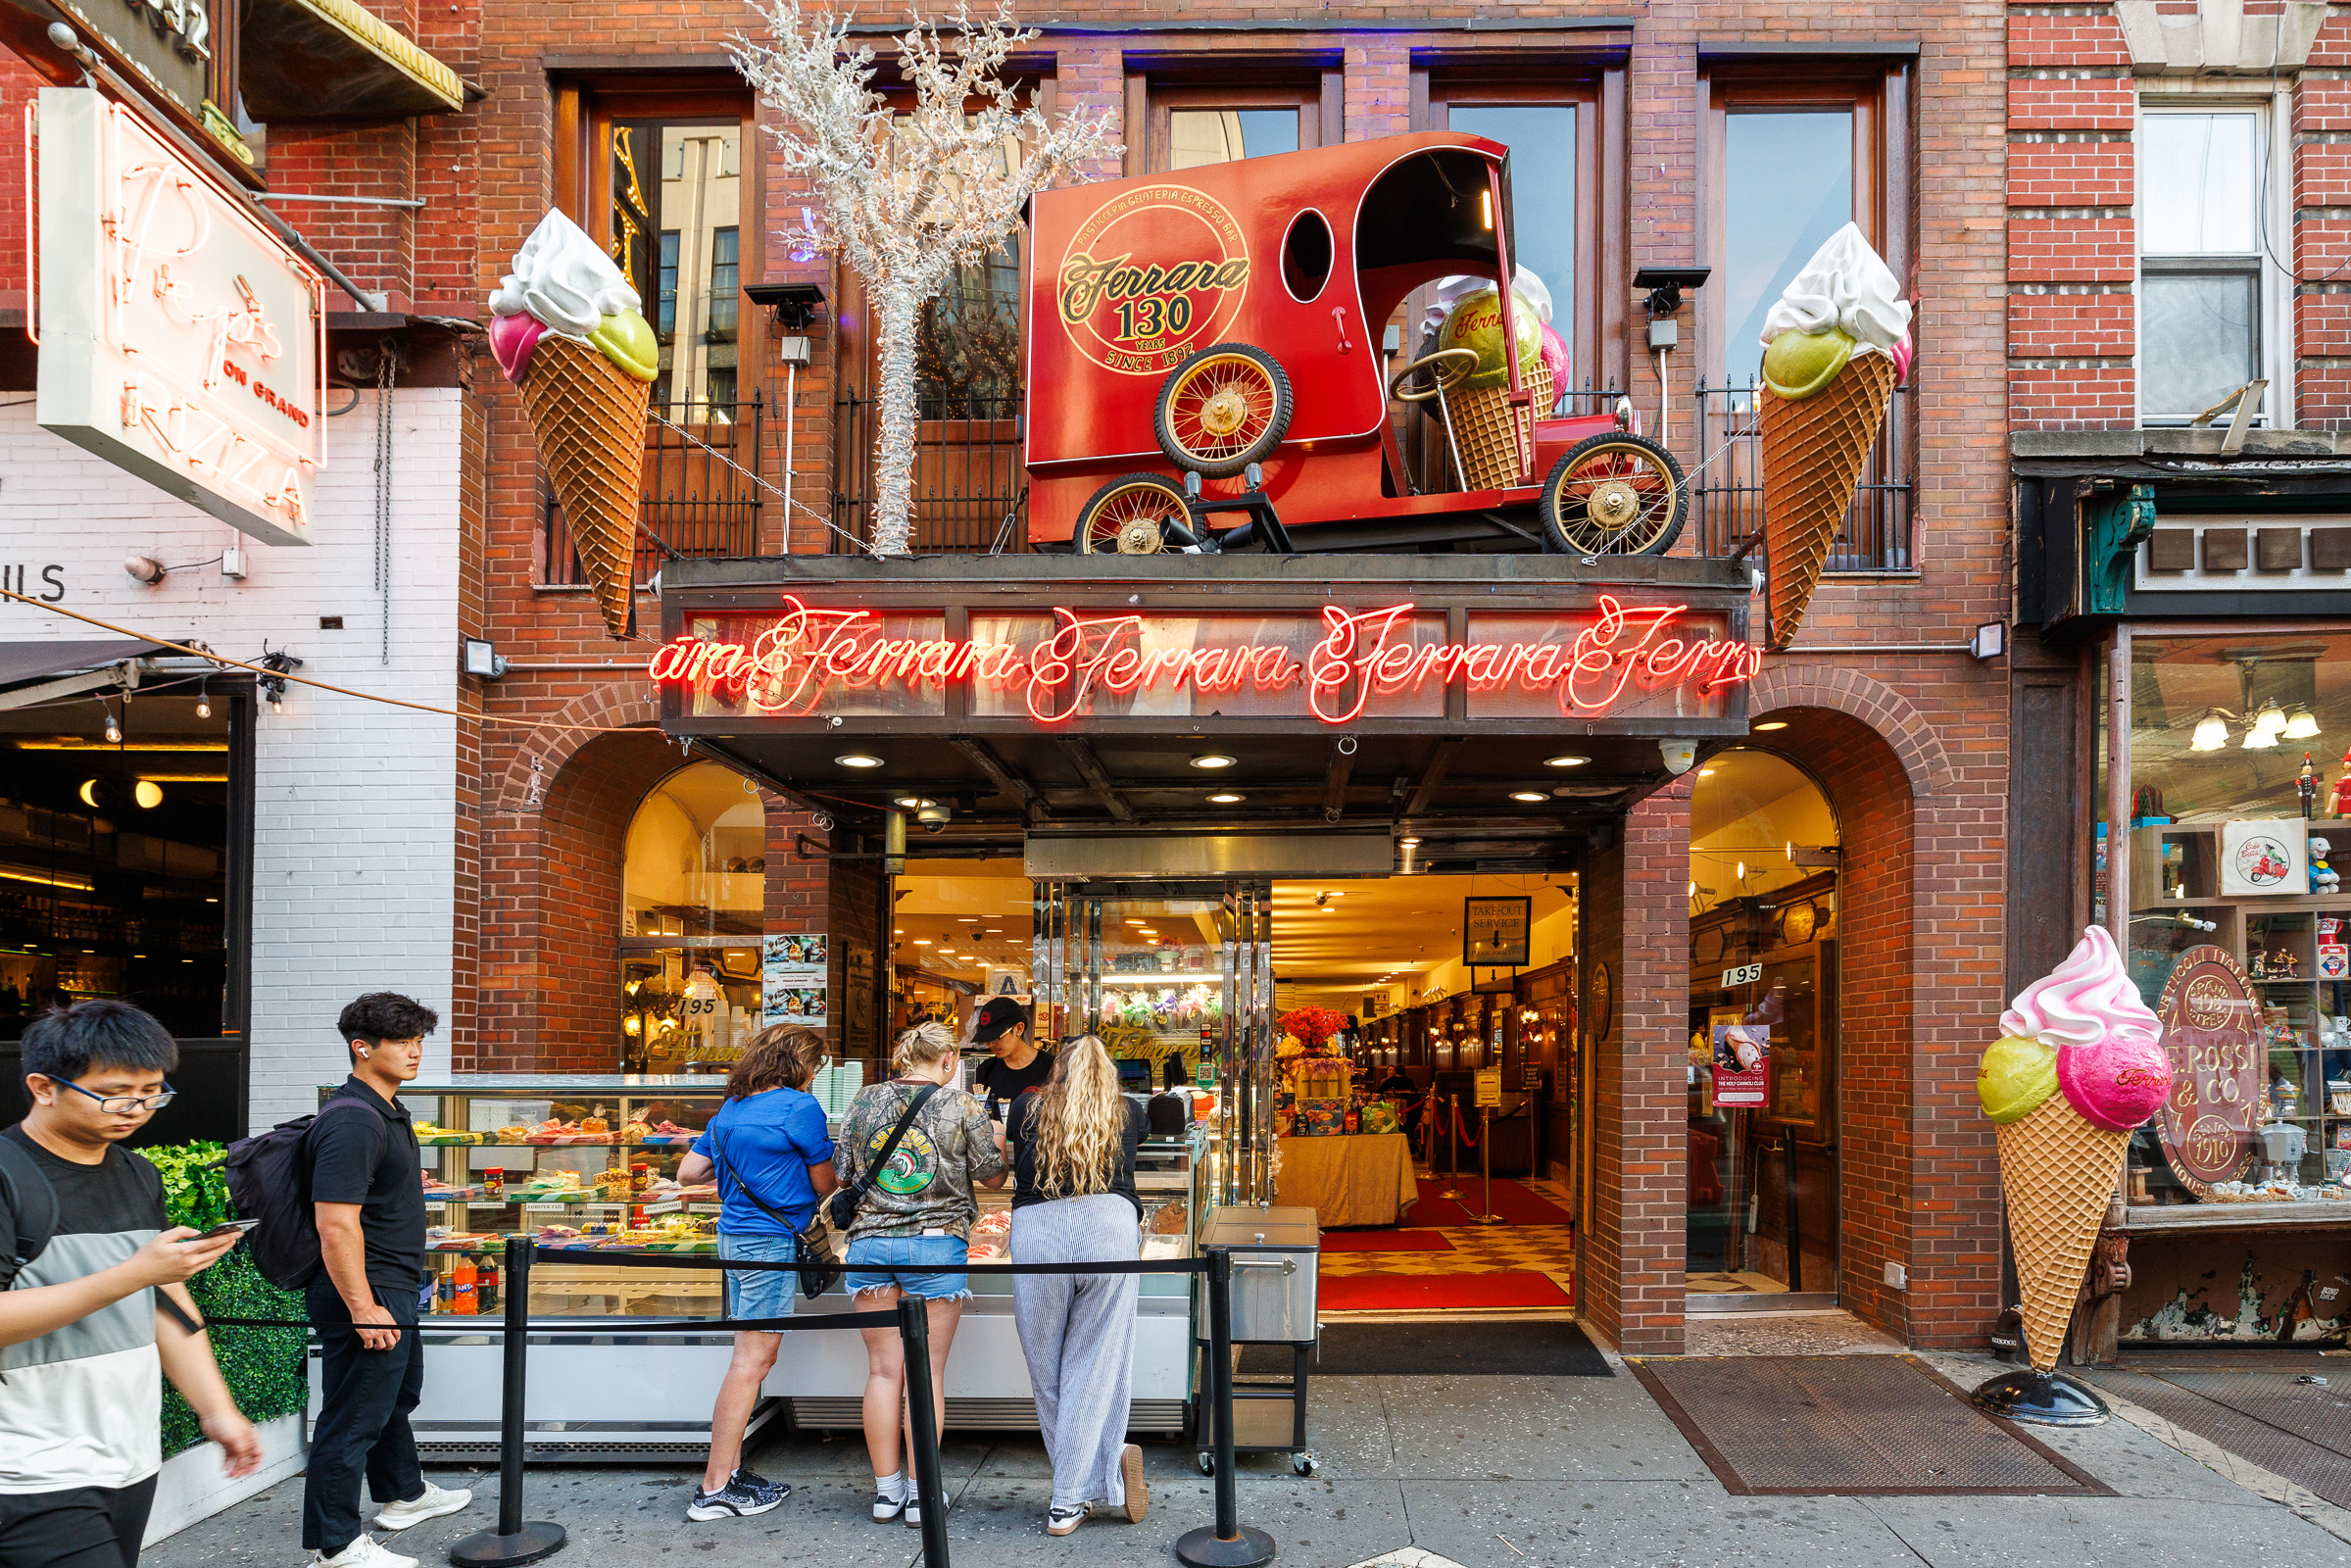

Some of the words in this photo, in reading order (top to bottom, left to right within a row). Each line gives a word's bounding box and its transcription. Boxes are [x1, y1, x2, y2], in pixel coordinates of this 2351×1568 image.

[1077, 201, 1128, 246] PASTICCERIA
[1222, 221, 1239, 243] BAR
[1061, 252, 1250, 324] Ferrara
[1113, 294, 1193, 341] 130
[1135, 338, 1165, 351] YEARS
[1105, 351, 1152, 370] SINCE
[1161, 342, 1196, 368] 1892
[223, 359, 247, 387] ON
[253, 379, 311, 429] GRAND
[747, 594, 1015, 711] Ferrara
[1026, 607, 1298, 723] Ferrara
[1309, 603, 1569, 722] Ferrara
[1472, 906, 1523, 916] TAKE-OUT
[1473, 918, 1520, 928] SERVICE
[1726, 964, 1760, 986] 195
[2156, 948, 2207, 1022] ARTICOLI
[2213, 948, 2263, 1019] ITALIANI
[2190, 979, 2229, 998] GRAND
[679, 999, 716, 1015] 195
[2188, 1007, 2229, 1026] STREET
[2178, 1079, 2199, 1107] &
[2206, 1077, 2246, 1103] CO.
[2192, 1121, 2233, 1142] SINCE
[2195, 1138, 2229, 1164] 1910
[659, 1201, 681, 1210] CANNOLI
[456, 1282, 474, 1294] FANTA
